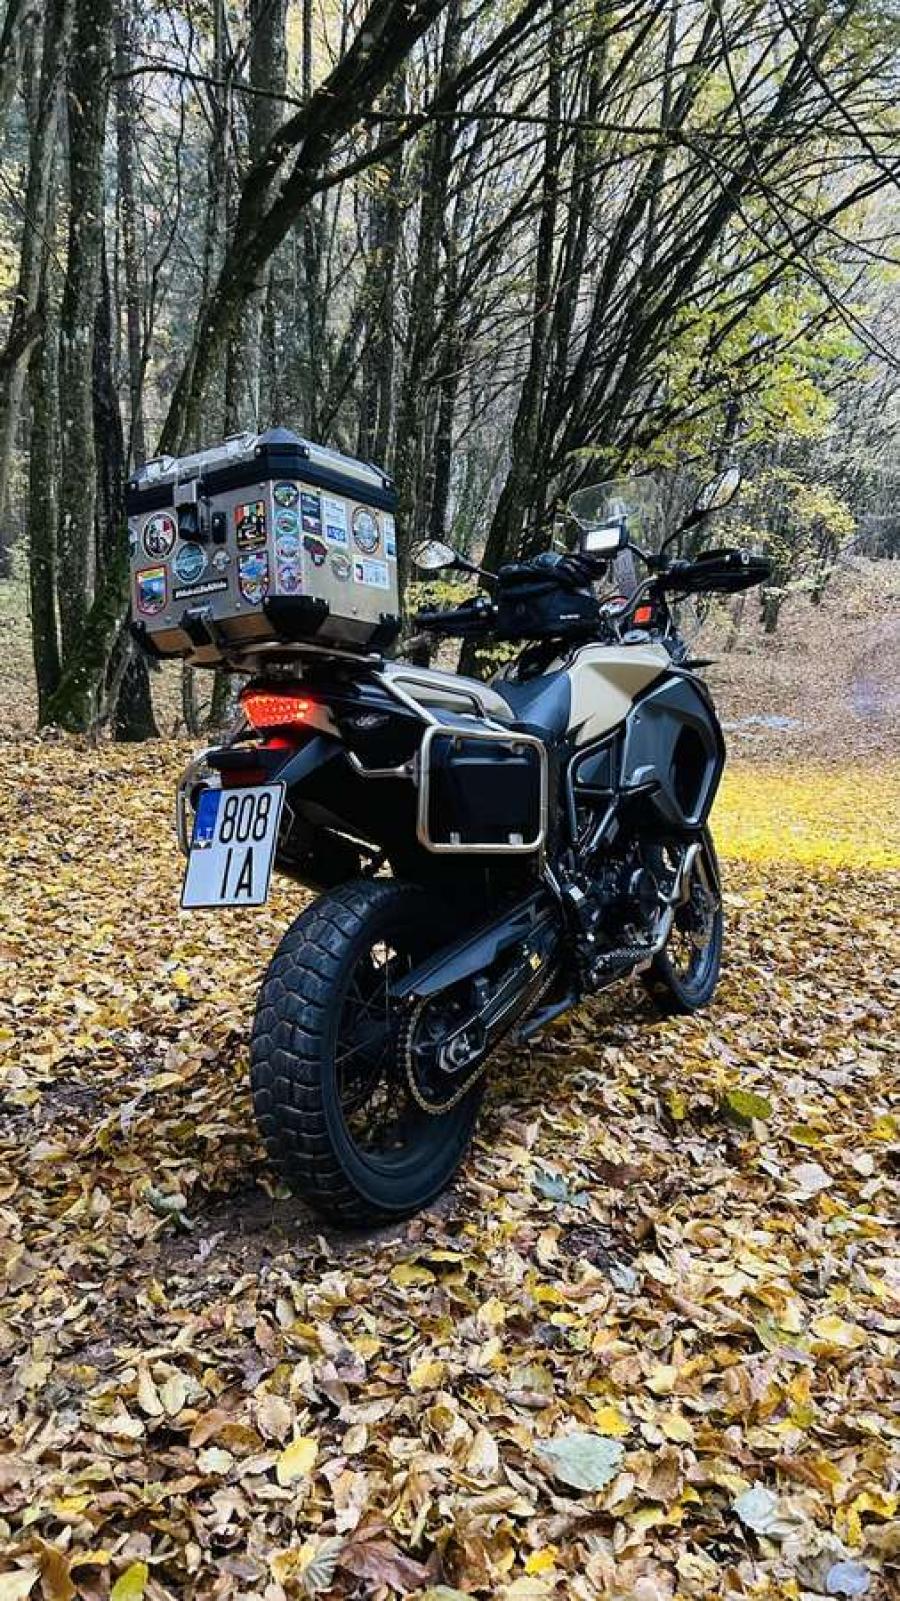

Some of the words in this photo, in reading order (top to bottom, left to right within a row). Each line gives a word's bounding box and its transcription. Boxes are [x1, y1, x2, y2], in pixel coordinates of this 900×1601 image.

[198, 827, 213, 840] LT
[219, 793, 272, 843] 808
[220, 846, 254, 898] IA
